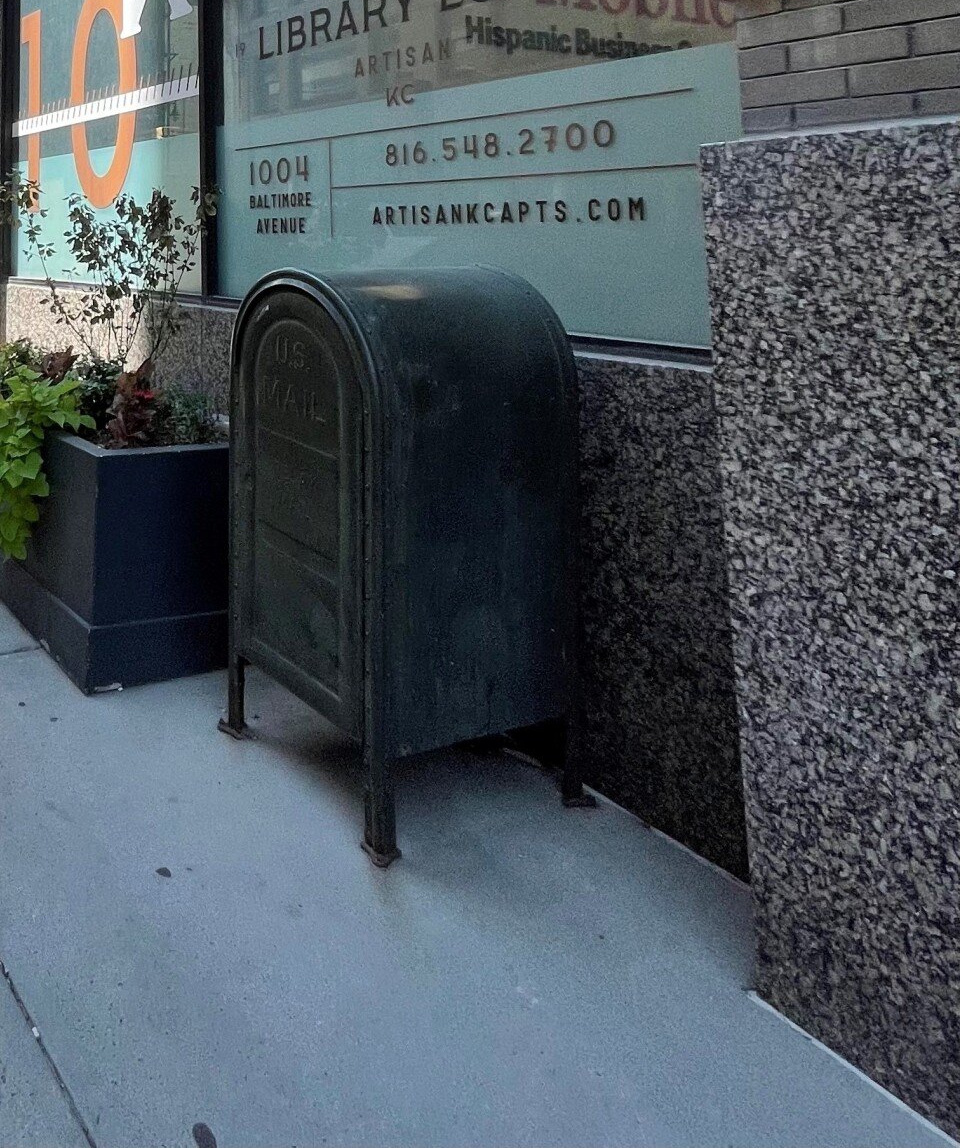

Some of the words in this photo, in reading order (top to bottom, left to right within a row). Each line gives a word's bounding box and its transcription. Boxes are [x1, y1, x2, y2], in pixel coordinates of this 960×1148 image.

[465, 14, 573, 53] Hispanic
[355, 38, 453, 79] ARTISAN
[386, 83, 415, 108] KC
[385, 119, 616, 167] 816.548.2700
[249, 155, 310, 186] 1004
[249, 192, 312, 209] BALTIMORE
[372, 196, 647, 226] ARTISANKCAPTS.COM
[256, 217, 306, 235] AVENUE
